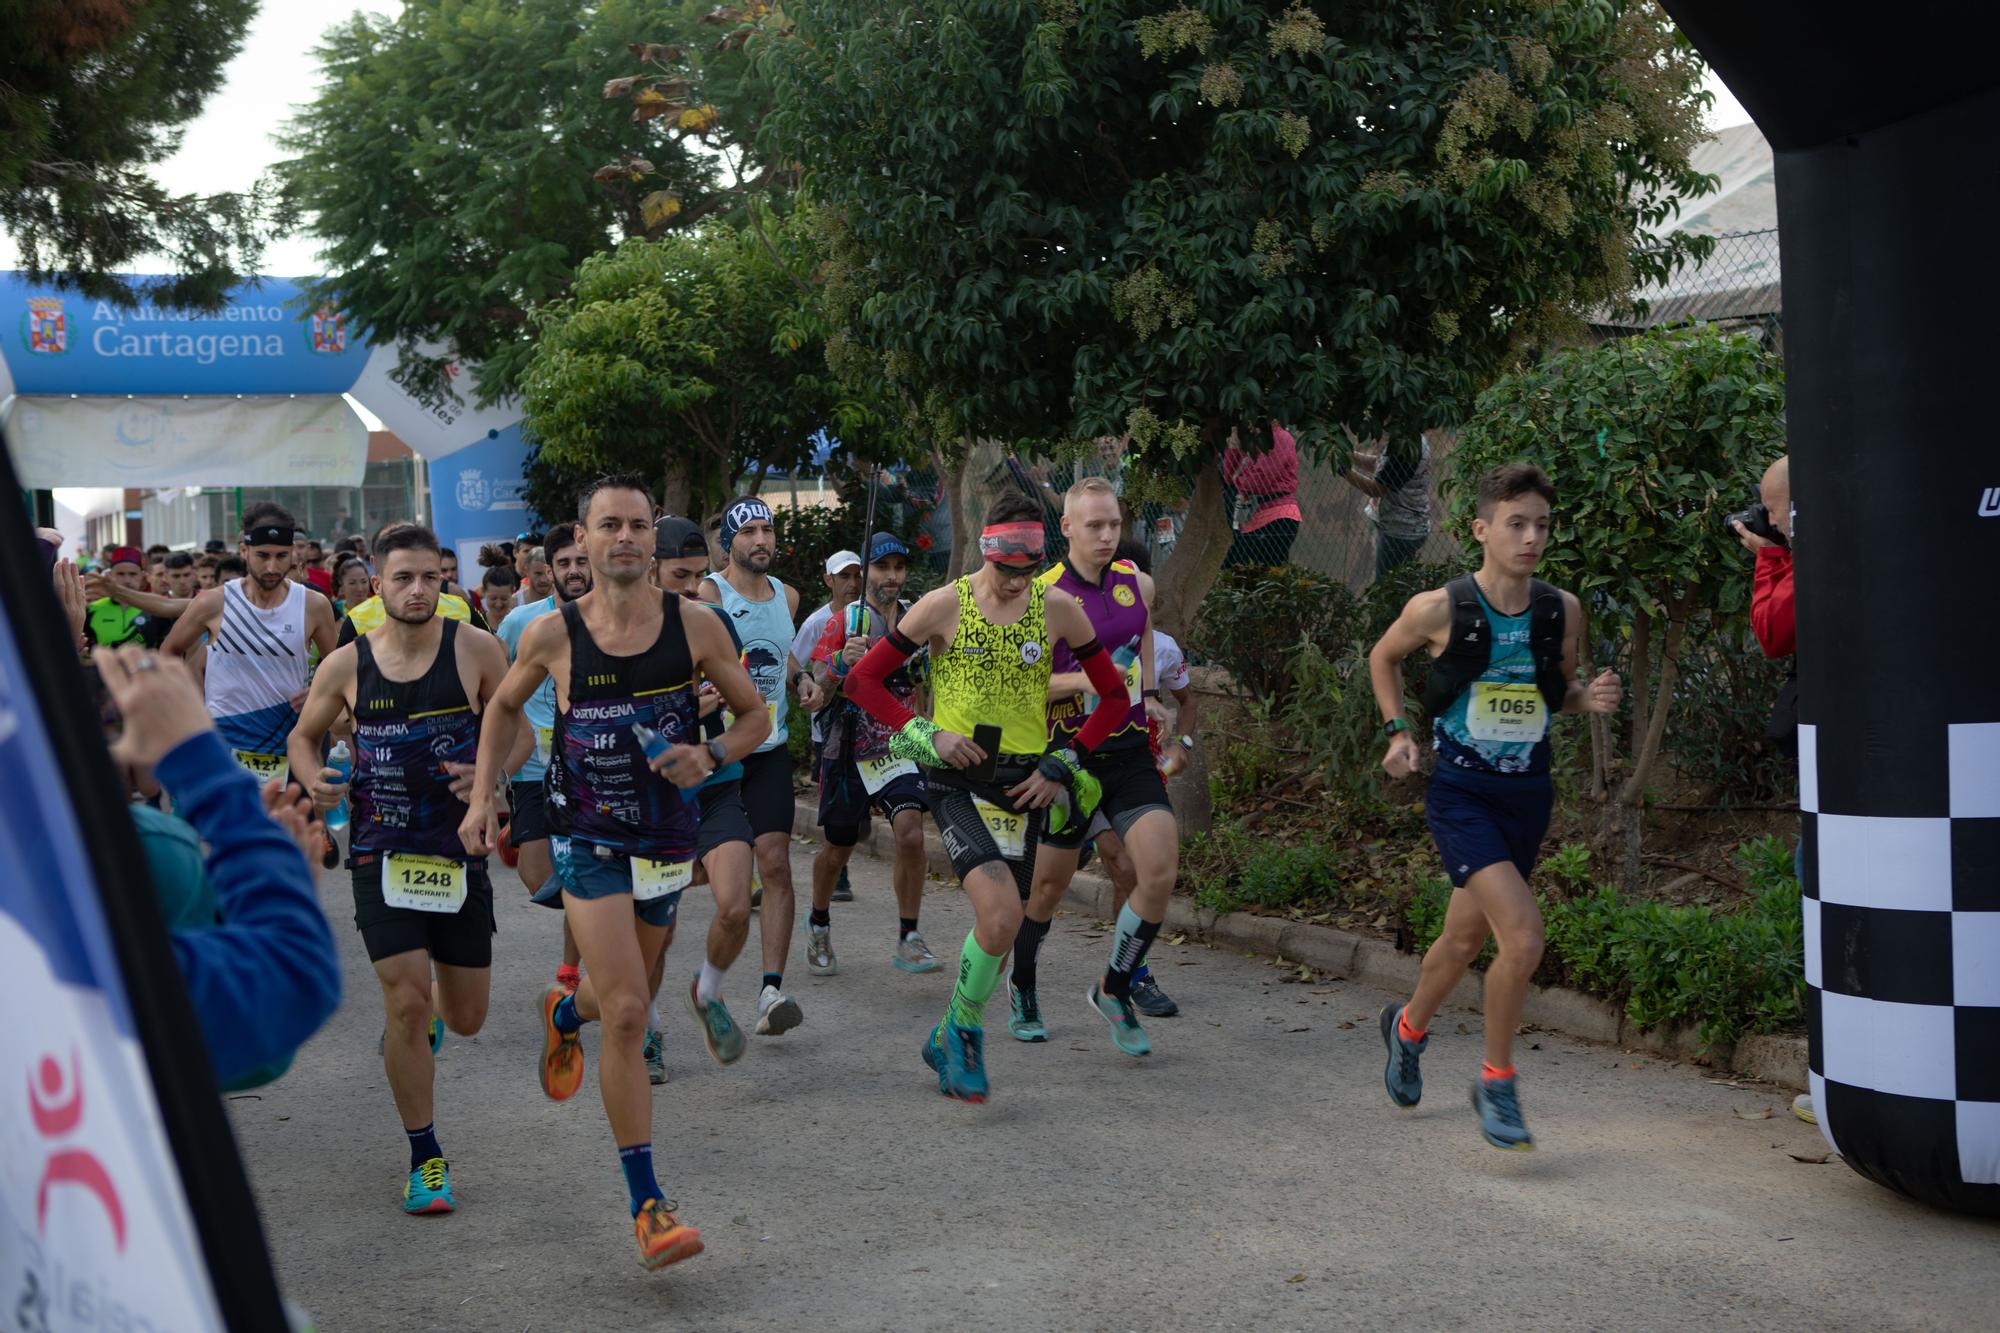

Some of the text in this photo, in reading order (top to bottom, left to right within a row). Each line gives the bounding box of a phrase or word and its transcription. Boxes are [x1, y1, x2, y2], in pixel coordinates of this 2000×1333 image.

[93, 325, 285, 365] Cartagena
[1488, 697, 1536, 715] 1065
[401, 869, 452, 887] 1248
[661, 868, 683, 879] PABLO
[403, 887, 451, 898] MARCHANTE
